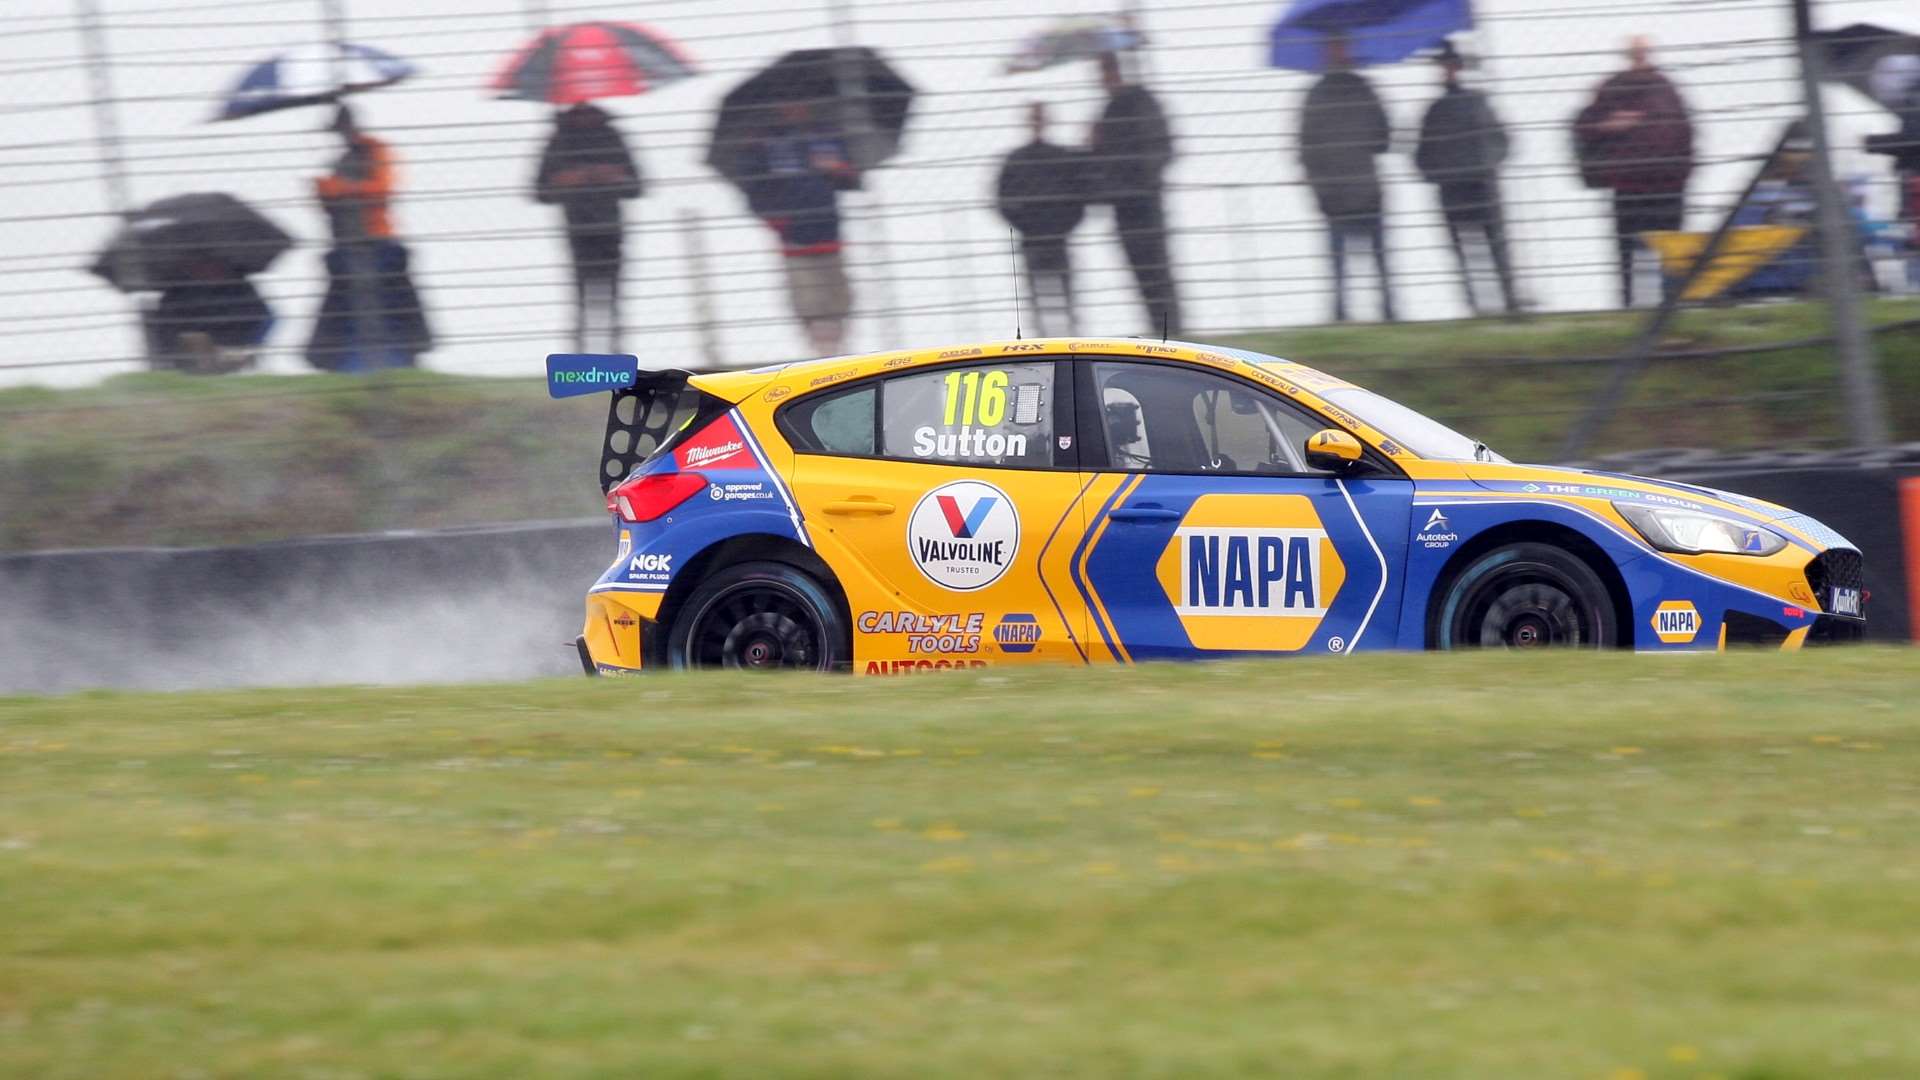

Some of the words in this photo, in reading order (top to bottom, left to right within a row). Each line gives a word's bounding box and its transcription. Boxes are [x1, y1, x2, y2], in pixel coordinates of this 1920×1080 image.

[554, 366, 630, 383] nexdrive
[943, 370, 1008, 427] 116
[913, 426, 1027, 457] Sutton
[686, 440, 743, 464] Milwaukee
[725, 483, 762, 493] approved
[1547, 484, 1580, 494] THE
[1584, 487, 1641, 499] GREEN
[1416, 532, 1458, 541] Autotech
[918, 536, 1004, 566] VALVOLINE
[629, 554, 673, 572] NGK
[946, 566, 980, 574] TRUSTED
[1188, 535, 1315, 608] NAPA
[857, 611, 984, 634] CARLYLE
[1659, 611, 1694, 632] NAPA
[1000, 624, 1033, 642] NAPA
[908, 635, 980, 653] TOOLS
